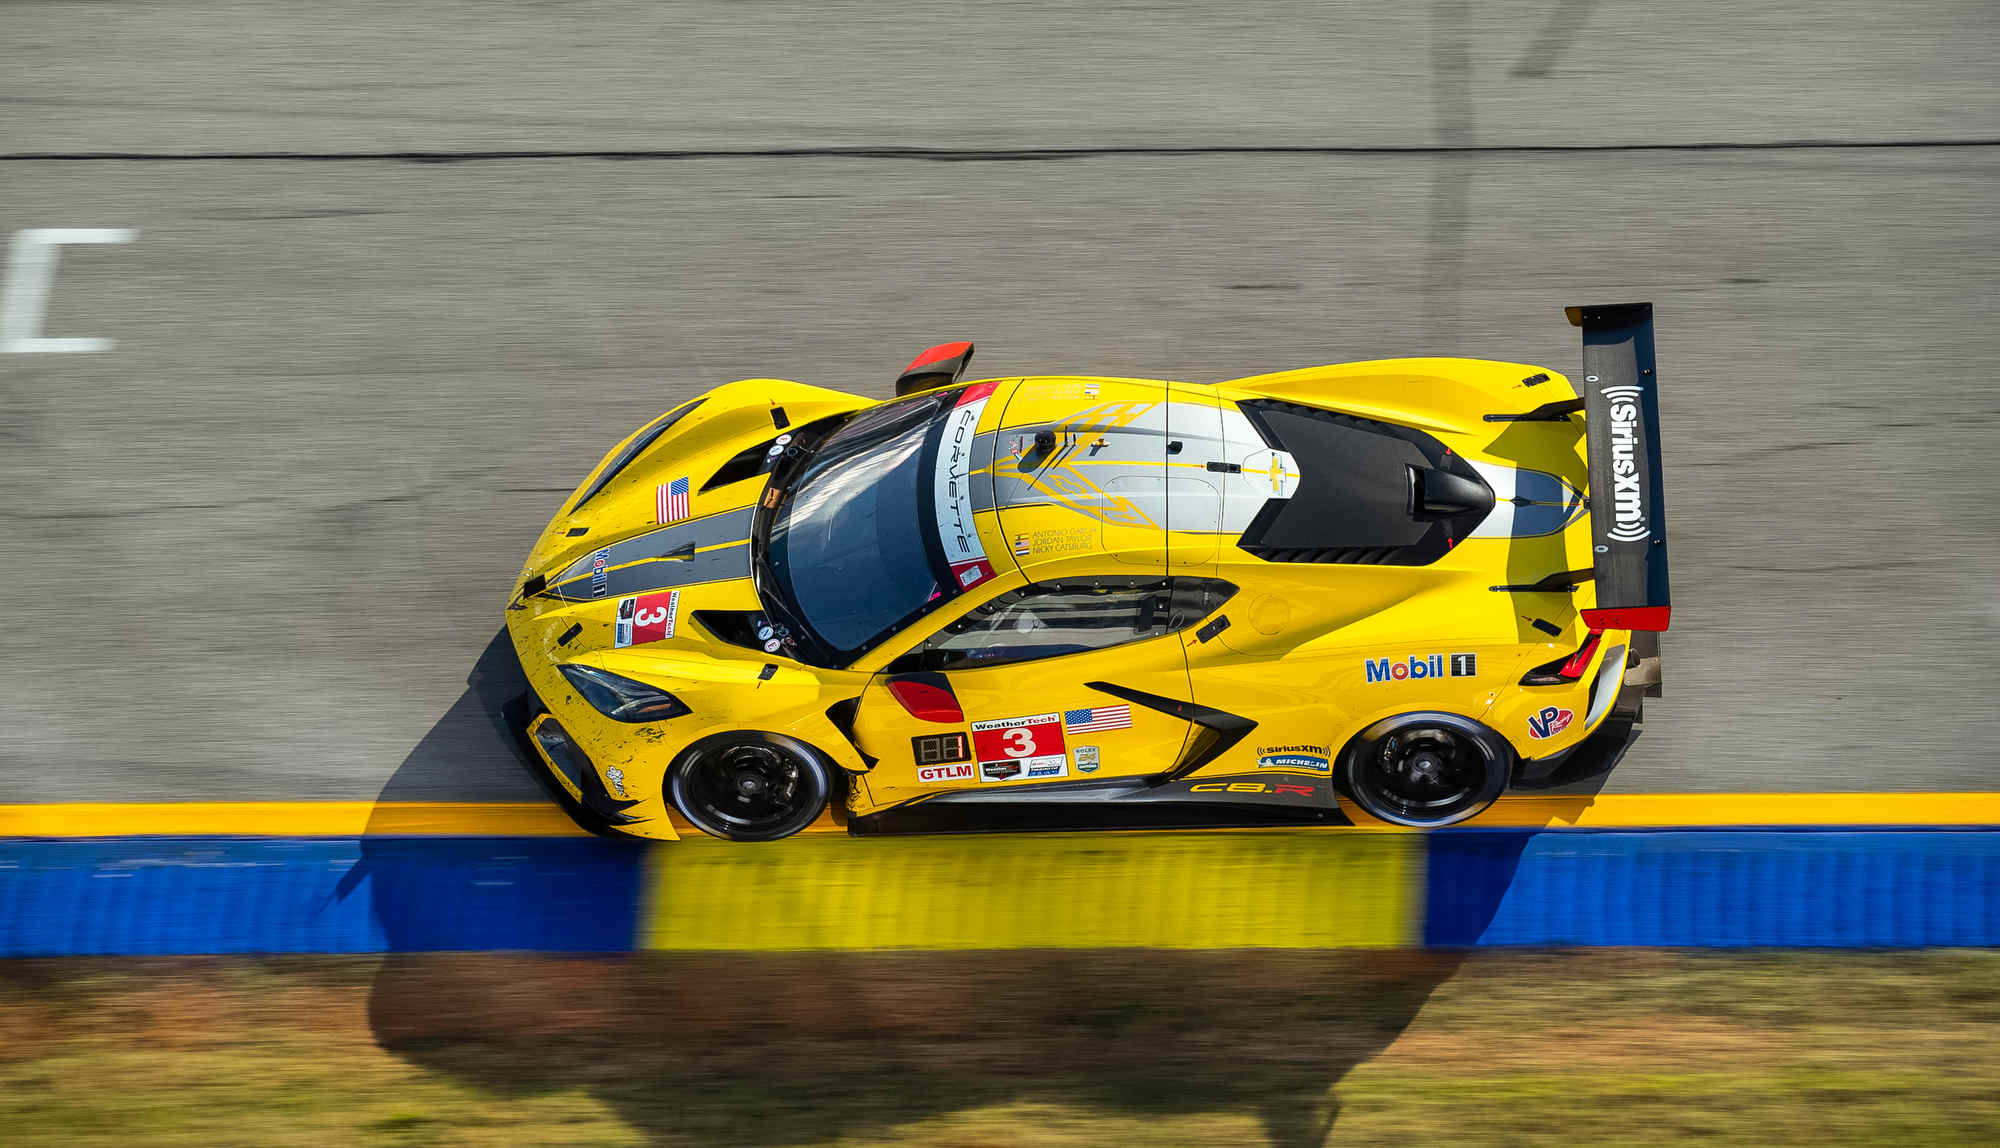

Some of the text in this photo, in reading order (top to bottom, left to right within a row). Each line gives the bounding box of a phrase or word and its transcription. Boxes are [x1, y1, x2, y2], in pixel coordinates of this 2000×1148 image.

[949, 409, 971, 553] CORVETTE
[634, 606, 668, 627] 3
[1365, 655, 1444, 682] Mobil
[974, 715, 1056, 730] WeatherTech
[1527, 706, 1559, 738] VP
[1002, 727, 1037, 758] 3
[920, 765, 972, 780] GTLM
[1275, 758, 1328, 769] MICHELIN
[1190, 782, 1315, 797] C8.R
